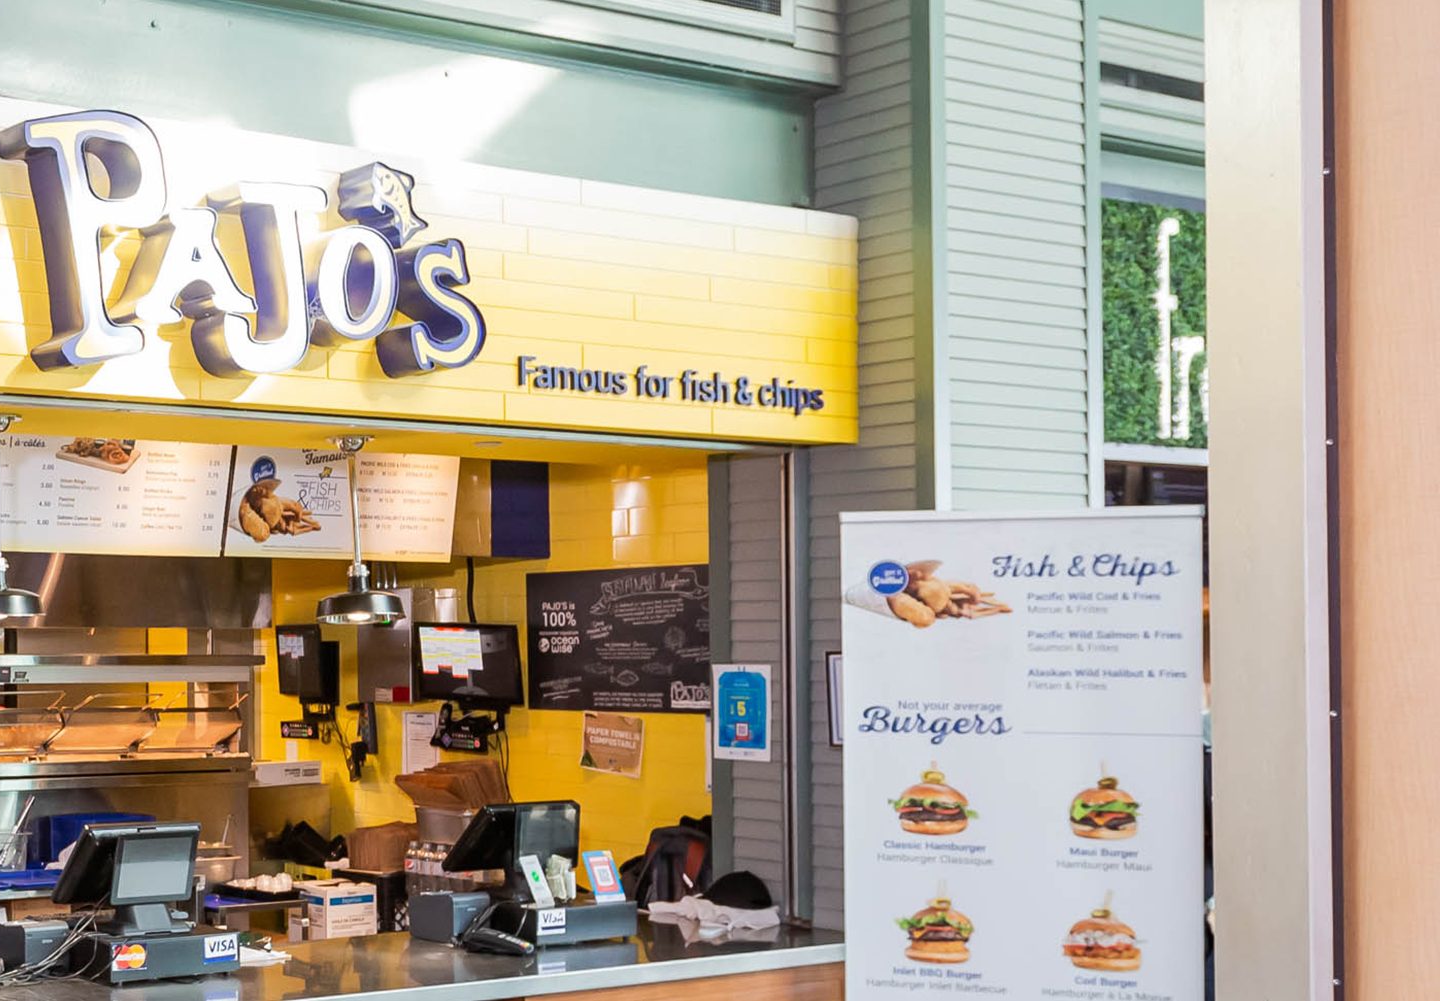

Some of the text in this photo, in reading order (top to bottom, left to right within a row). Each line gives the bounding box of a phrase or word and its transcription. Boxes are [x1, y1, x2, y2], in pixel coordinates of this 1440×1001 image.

[518, 355, 825, 416] Famous for fish & chips
[308, 482, 337, 496] FISH
[309, 500, 341, 511] CHIPS
[992, 553, 1180, 586] Fish & Chips
[1027, 592, 1161, 600] Pacific Wild Cod & Fries
[569, 601, 575, 610] is
[542, 612, 576, 627] 100%
[1027, 630, 1183, 639] Pacific Wild Salmon & Fries
[551, 637, 579, 645] ocean
[551, 645, 572, 653] wise
[1028, 669, 1187, 678] Alaskan Wild Halibut & Fries
[737, 701, 746, 716] 5
[898, 700, 1003, 713] Not your average
[587, 727, 609, 736] PAPER
[859, 706, 1013, 745] Burgers
[589, 736, 637, 749] COMPOSTABLE
[883, 840, 986, 854] Classic Hamburger
[1070, 847, 1139, 859] Maui Burger
[209, 939, 235, 953] VISA
[946, 970, 982, 980] Burger
[1074, 976, 1137, 988] Cod Burger
